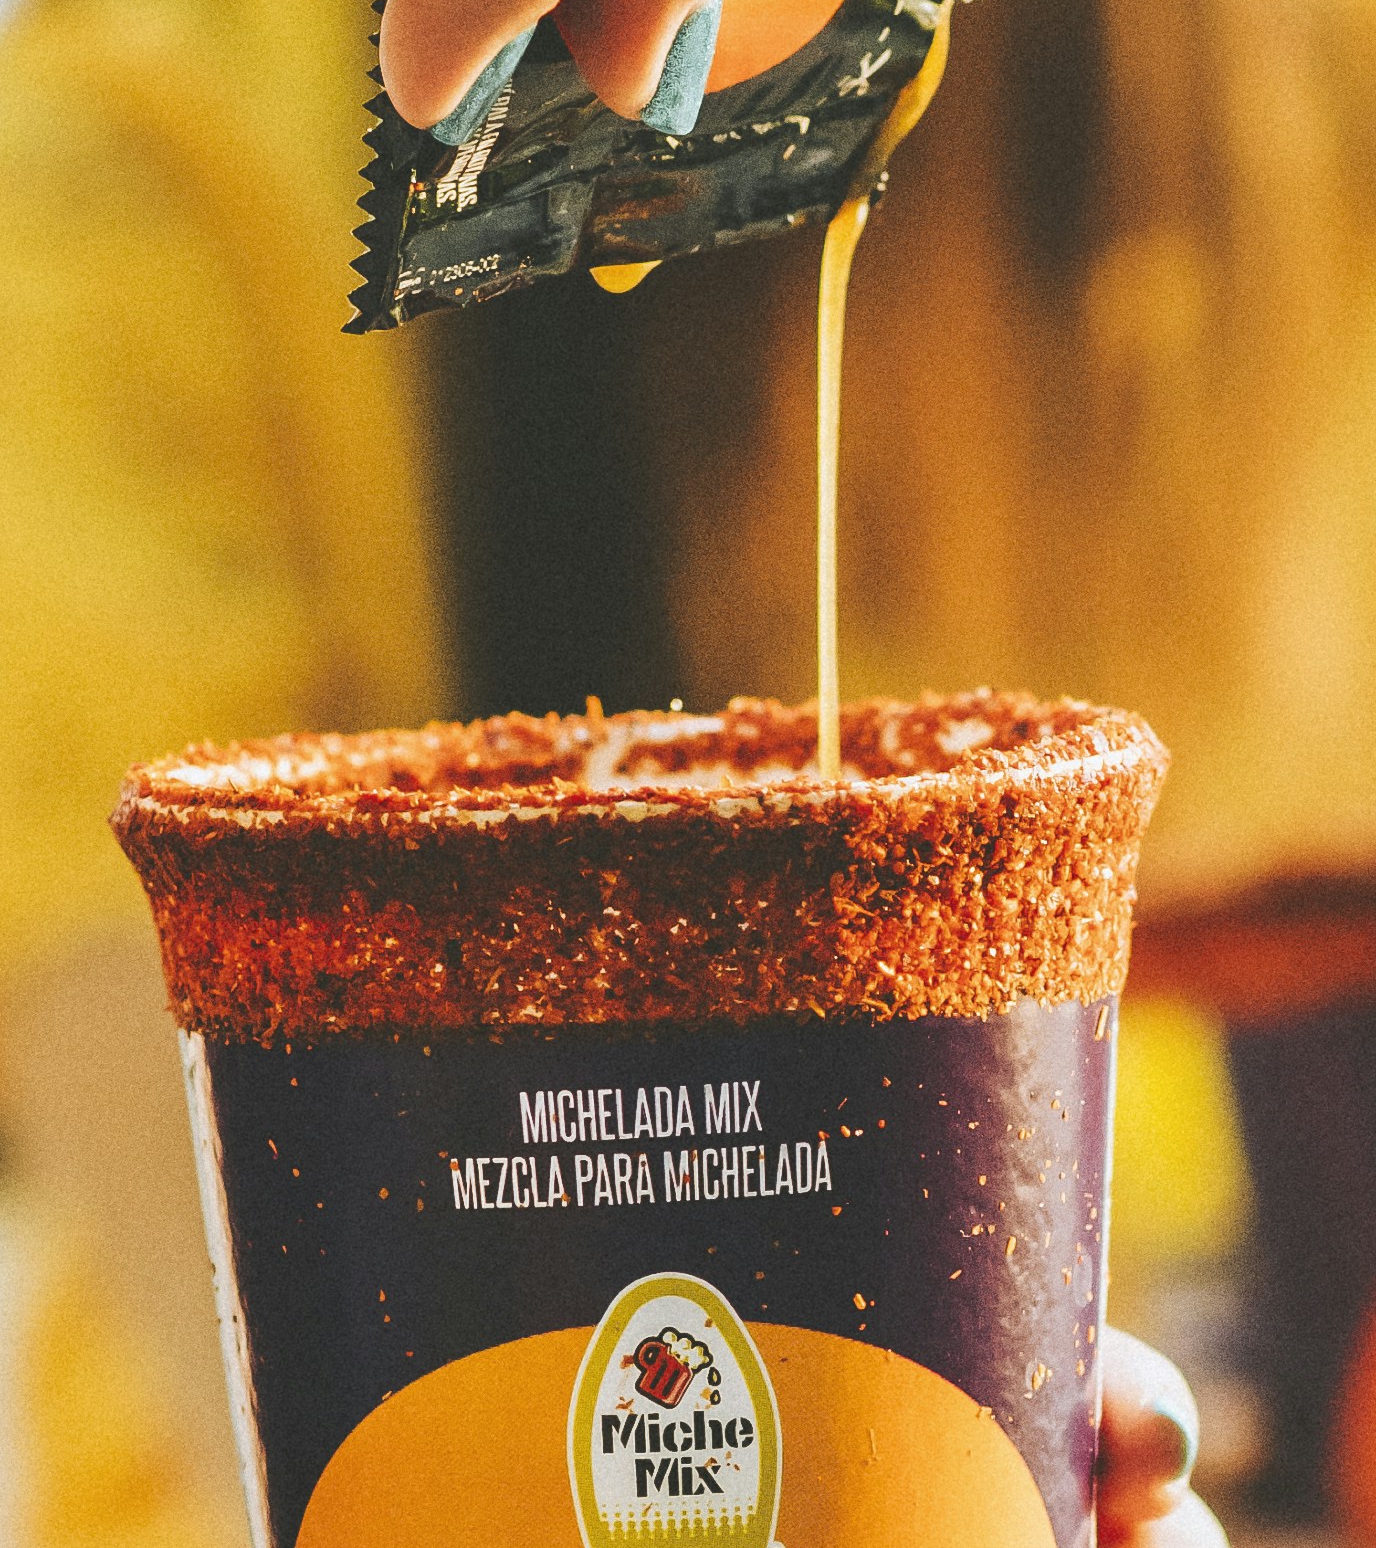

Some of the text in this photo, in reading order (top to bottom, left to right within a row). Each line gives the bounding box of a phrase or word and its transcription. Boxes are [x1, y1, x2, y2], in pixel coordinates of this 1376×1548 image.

[519, 1080, 763, 1144] MICHELADA MIX
[450, 1140, 833, 1210] MEZCLA PARA MICHELADA
[600, 1410, 754, 1454] Miche
[635, 1456, 724, 1497] Mix
